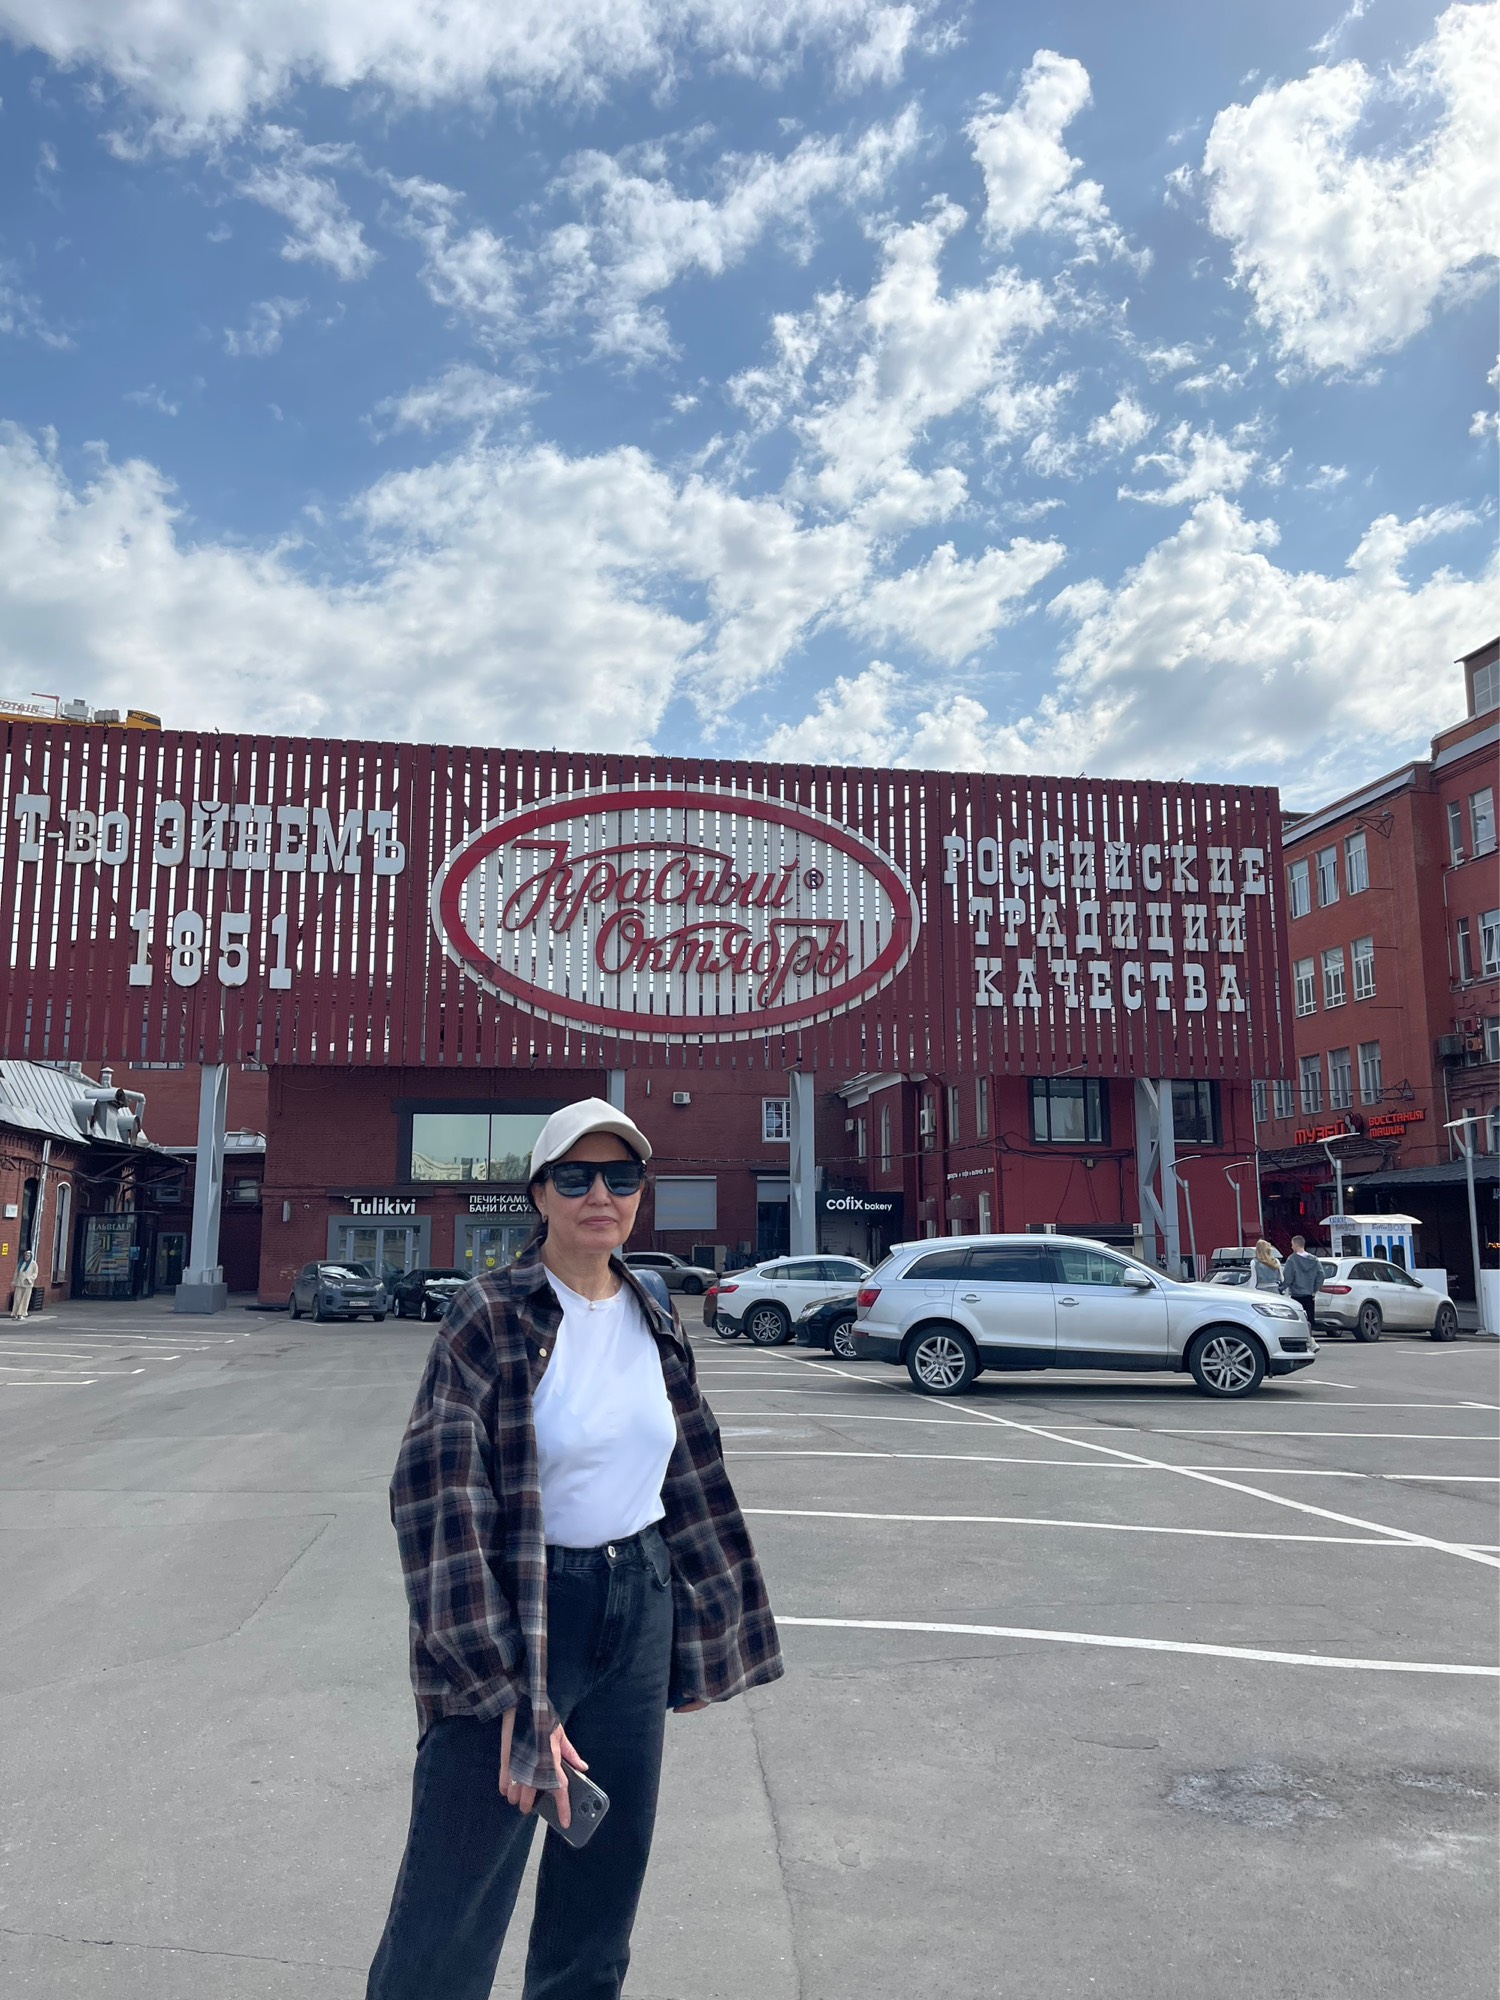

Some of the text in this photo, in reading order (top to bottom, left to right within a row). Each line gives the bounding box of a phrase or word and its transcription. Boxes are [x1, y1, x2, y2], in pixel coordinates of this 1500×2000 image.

[154, 799, 406, 876] ЭЙНЕМЪ
[943, 835, 1266, 896] РОССИЙСКИЕ
[501, 839, 800, 934] Красный
[129, 908, 293, 990] 1851
[970, 896, 1245, 957] ТРАДИЦИИ
[595, 907, 854, 1008] Октябрь
[974, 956, 1246, 1013] КАЧЕСТВА
[350, 1197, 416, 1215] Tulikivi
[469, 1204, 497, 1213] БАНИ
[499, 1204, 507, 1213] И
[826, 1196, 893, 1212] cofix bakery
